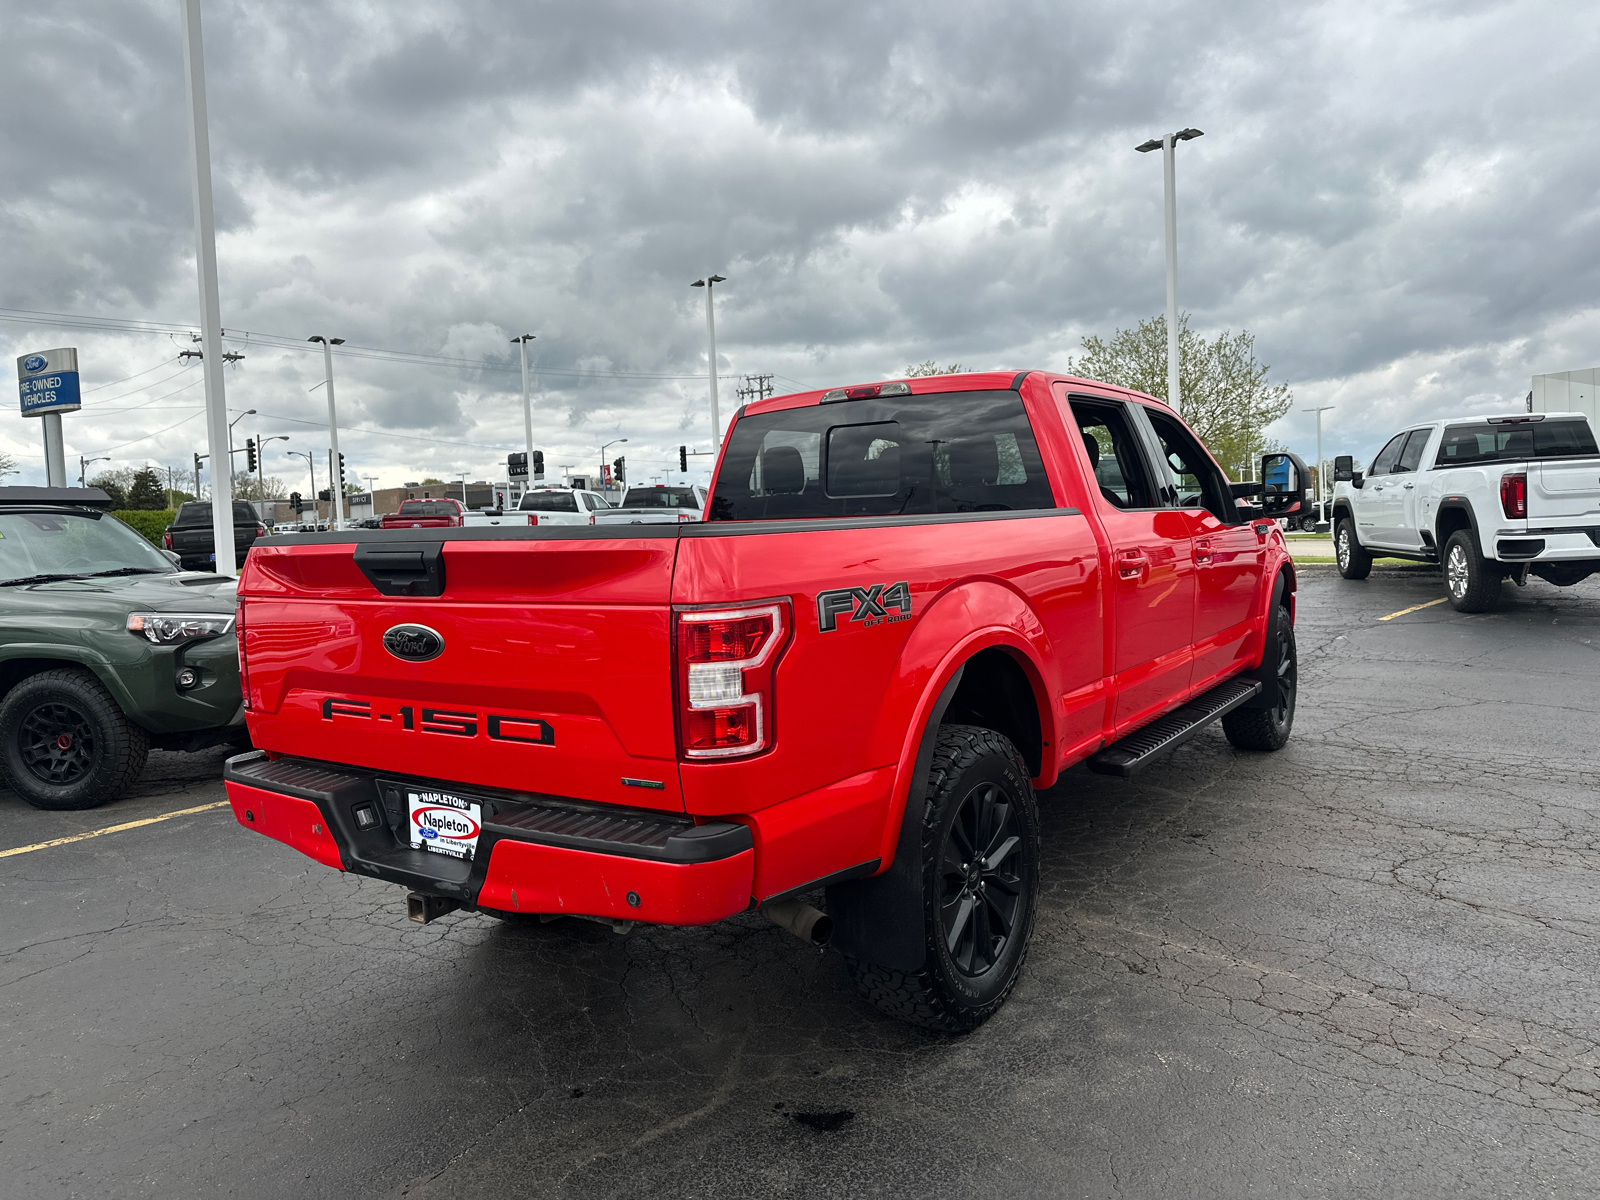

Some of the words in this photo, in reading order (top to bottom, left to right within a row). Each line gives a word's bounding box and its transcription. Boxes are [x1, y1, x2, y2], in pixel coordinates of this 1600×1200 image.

[26, 358, 40, 369] Ford
[20, 377, 61, 394] PRE-OWNED
[23, 391, 56, 406] VEHICLES
[510, 466, 537, 474] LINCON
[816, 580, 913, 634] FX4
[863, 618, 885, 628] OFF
[887, 613, 912, 624] ROAD
[394, 631, 427, 654] Ford
[322, 698, 556, 746] F-150
[422, 793, 464, 808] NAPLETON
[423, 811, 469, 834] Napleton
[428, 846, 464, 858] LIBERTYVILLE
[446, 839, 475, 850] Libertyville
